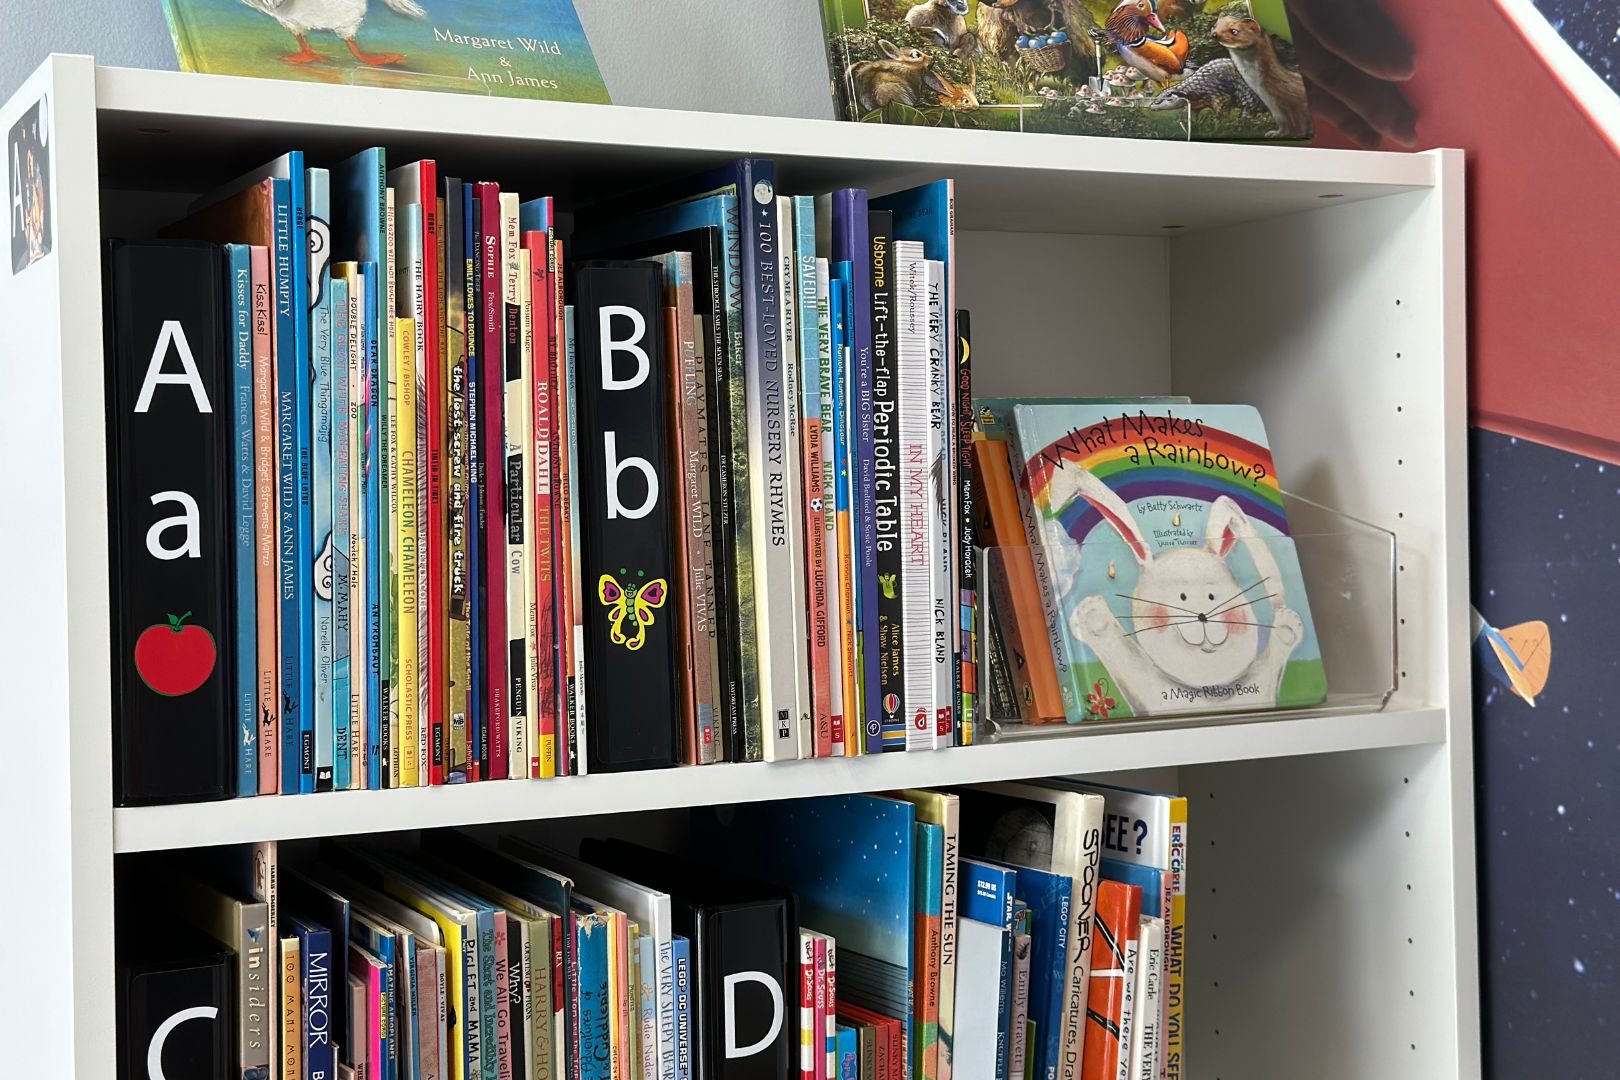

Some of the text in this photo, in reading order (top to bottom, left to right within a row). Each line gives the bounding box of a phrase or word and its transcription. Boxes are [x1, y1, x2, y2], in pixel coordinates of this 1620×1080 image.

[433, 27, 562, 55] Margaret Wild
[467, 66, 558, 89] Ann James
[499, 56, 512, 68] &
[13, 141, 25, 237] A
[508, 217, 517, 237] Mem
[509, 242, 517, 260] Fox
[468, 312, 474, 321] TO
[507, 272, 518, 302] Terry
[402, 331, 410, 365] COWLEY
[509, 308, 518, 344] Denton
[599, 305, 650, 391] B
[734, 331, 744, 365] Baker
[860, 347, 869, 379] You're
[133, 320, 213, 413] A
[257, 356, 270, 431] Margaret Wild
[277, 204, 294, 600] LITTLE HUMPTY MARGARET WILD & ANN JAMES
[759, 222, 784, 546] 100 BEST-LOVED NURSERY RHYMES
[861, 390, 870, 411] BIG
[872, 236, 896, 551] Usborne Lift-the-flap Periodic Table
[237, 269, 253, 546] Kisses for Daddy Frances David Legge
[818, 297, 834, 531] THE VERY BRAVE BEAR NICK BLAND
[861, 413, 871, 442] Sister
[1042, 410, 1204, 470] What Makes
[452, 365, 464, 593] the lost screw and fire truck
[537, 381, 551, 581] ROALD DAHL THE TWITS
[604, 431, 659, 519] b
[803, 256, 826, 647] SAVED!!! LYDIA WILLIAMS ILLUSTRATED BY LUCINDA GIFFORD
[929, 284, 946, 663] THE VERY CRANKY BEAR NICK BLAND
[1124, 436, 1266, 488] a Rainbow?
[145, 490, 201, 560] a
[318, 306, 331, 683] The Very Blue Thingamajig Oliver
[399, 450, 415, 533] CHAMELEON,
[510, 461, 521, 541] Particular
[864, 484, 872, 514] Bedford
[909, 444, 925, 565] IN MY HEART
[963, 480, 972, 543] Mem Fox Judy
[402, 536, 414, 614] CHAMELEON
[511, 551, 522, 574] Cow
[688, 450, 707, 631] Margaret WILD Julie VIVAS
[881, 625, 890, 685] Shaw Nielsen
[891, 623, 900, 676] Alice James
[1170, 683, 1260, 701] Magic Ribbon Book
[1172, 826, 1184, 856] ERIC
[943, 834, 956, 964] TAMING THE SUN
[929, 930, 938, 1006] Anthony Browne
[1058, 928, 1066, 948] CITY
[249, 947, 265, 1048] insiders
[309, 952, 328, 1048] MIRROR
[495, 959, 507, 1027] We All Go
[509, 962, 520, 1004] Why?
[535, 967, 547, 1034] HARRY
[660, 941, 673, 1043] The VERY SLEEPY
[724, 970, 785, 1060] D
[1014, 970, 1027, 1065] Emily Gravett
[1066, 965, 1084, 1048] Caricatures,
[1123, 949, 1137, 1054] Are we there
[1144, 949, 1159, 1048] Eric Carle THE
[1168, 925, 1183, 1045] WHAT DO YOU
[147, 1006, 218, 1080] C
[468, 1020, 479, 1063] MAMA
[643, 1008, 655, 1077] Rudie Nudie
